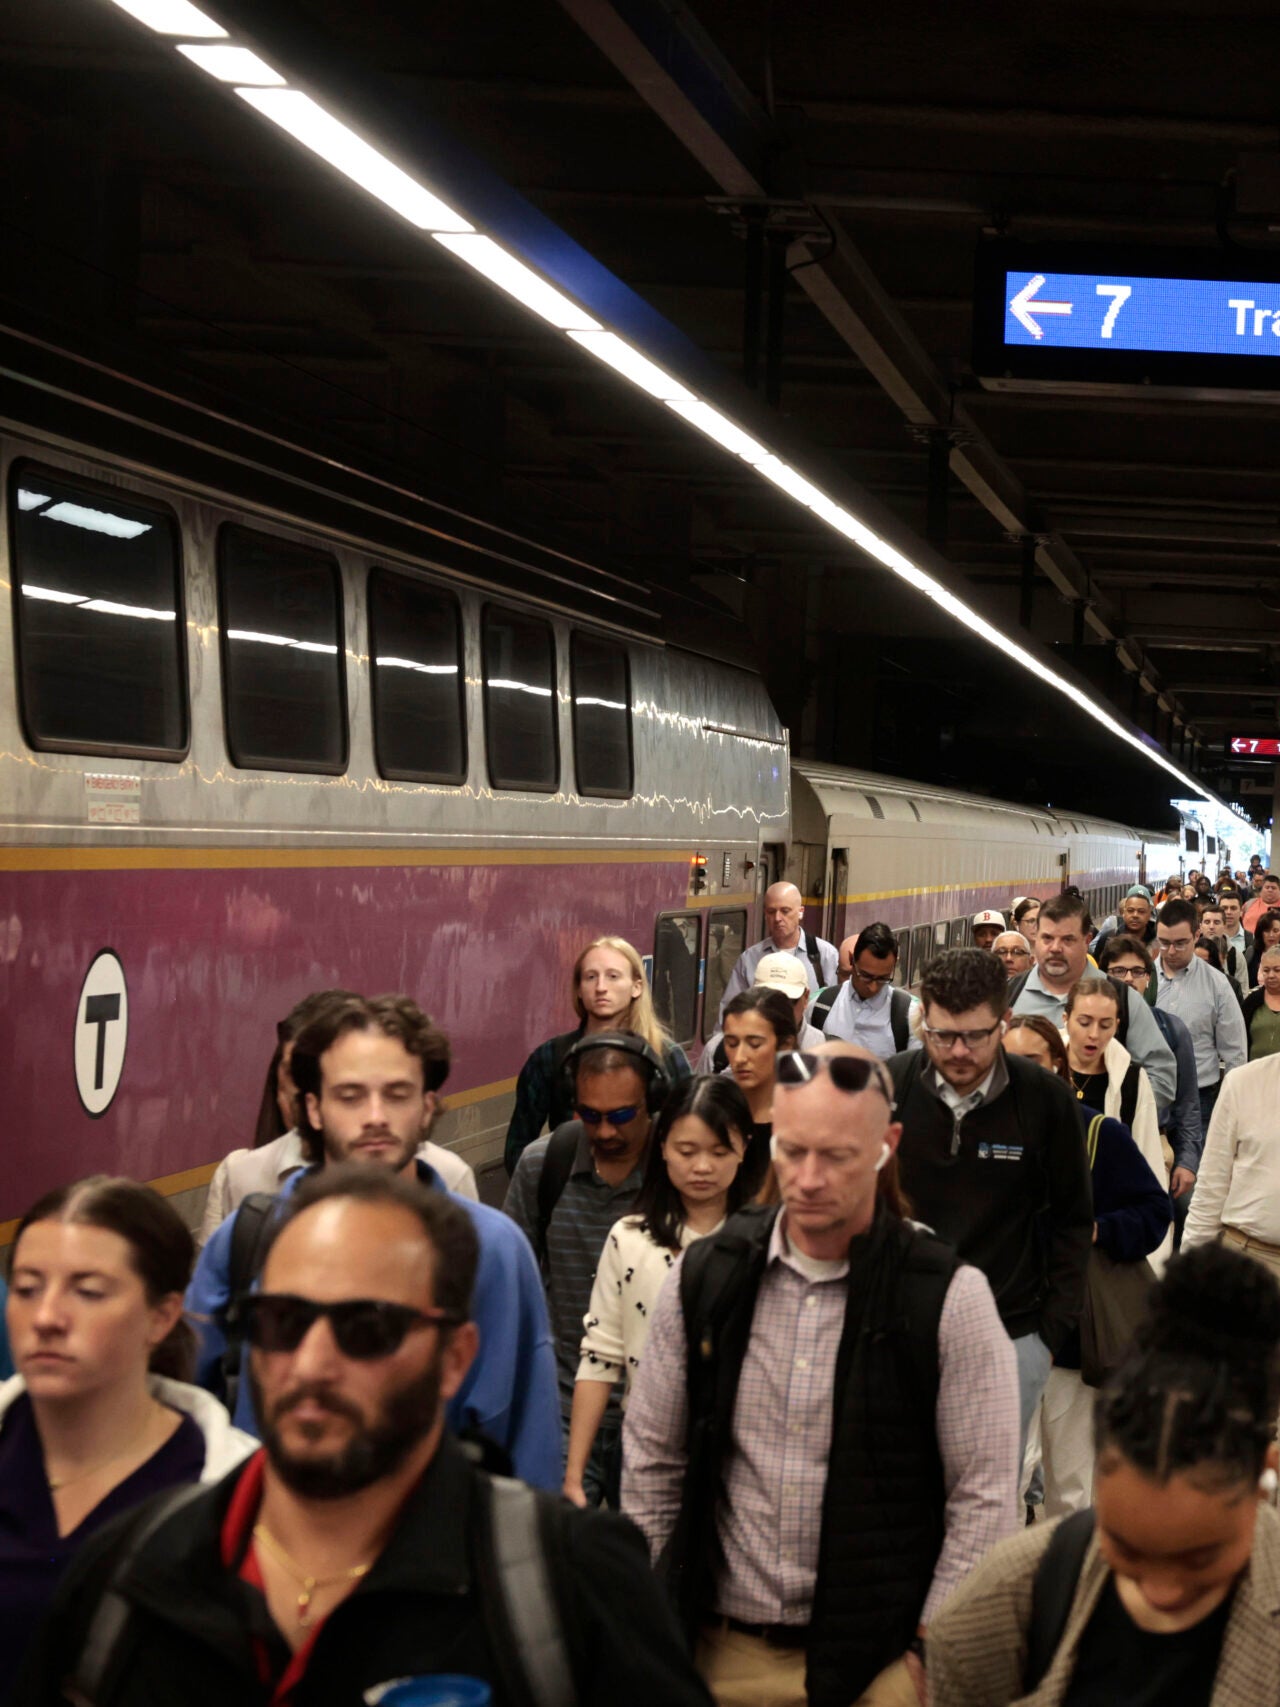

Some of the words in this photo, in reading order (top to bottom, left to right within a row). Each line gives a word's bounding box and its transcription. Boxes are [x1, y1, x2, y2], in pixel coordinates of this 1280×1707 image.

[1096, 284, 1132, 339] 7
[1249, 741, 1259, 753] 7
[983, 912, 991, 921] B
[85, 993, 121, 1090] T
